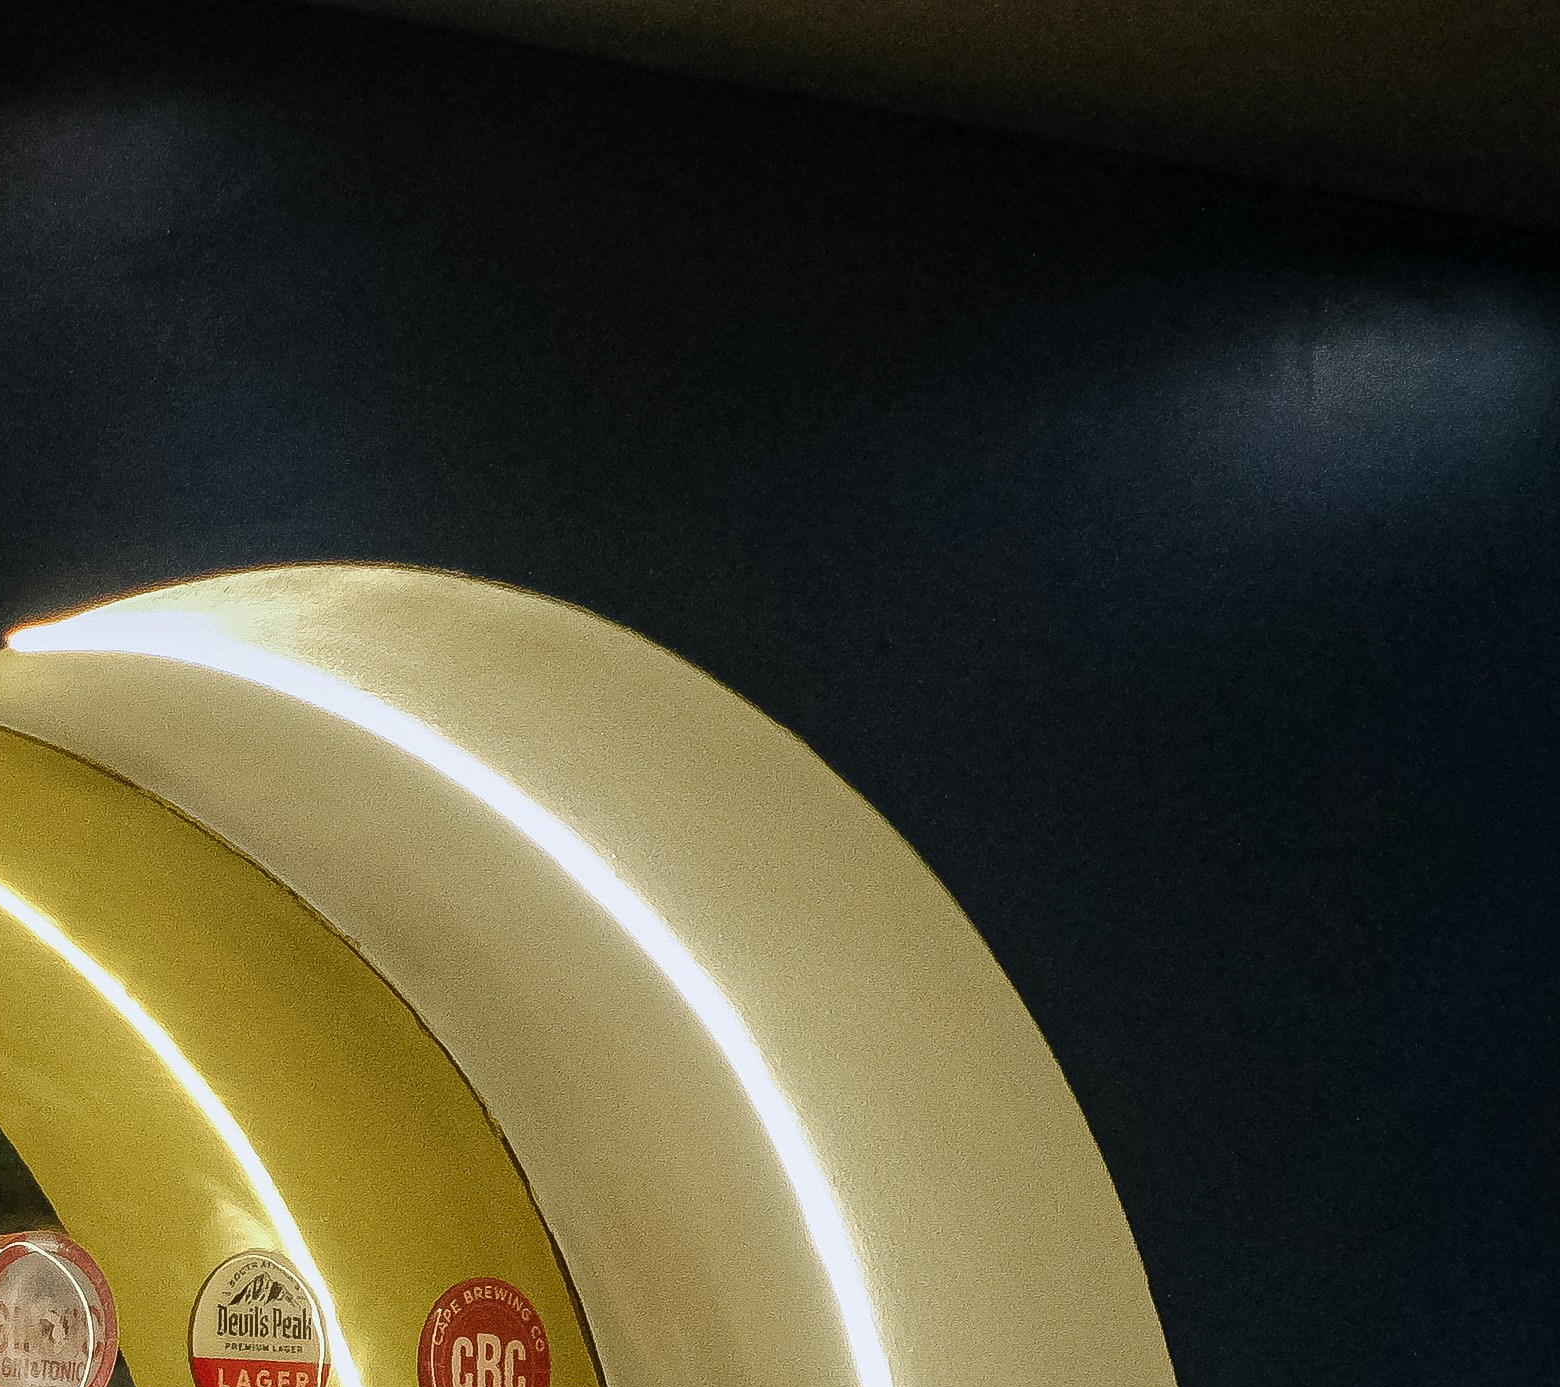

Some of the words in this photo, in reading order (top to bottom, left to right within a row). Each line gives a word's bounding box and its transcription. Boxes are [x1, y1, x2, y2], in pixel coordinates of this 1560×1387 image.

[216, 1303, 270, 1338] Devil's
[272, 1307, 312, 1340] Peak
[463, 1285, 533, 1322] BREWING
